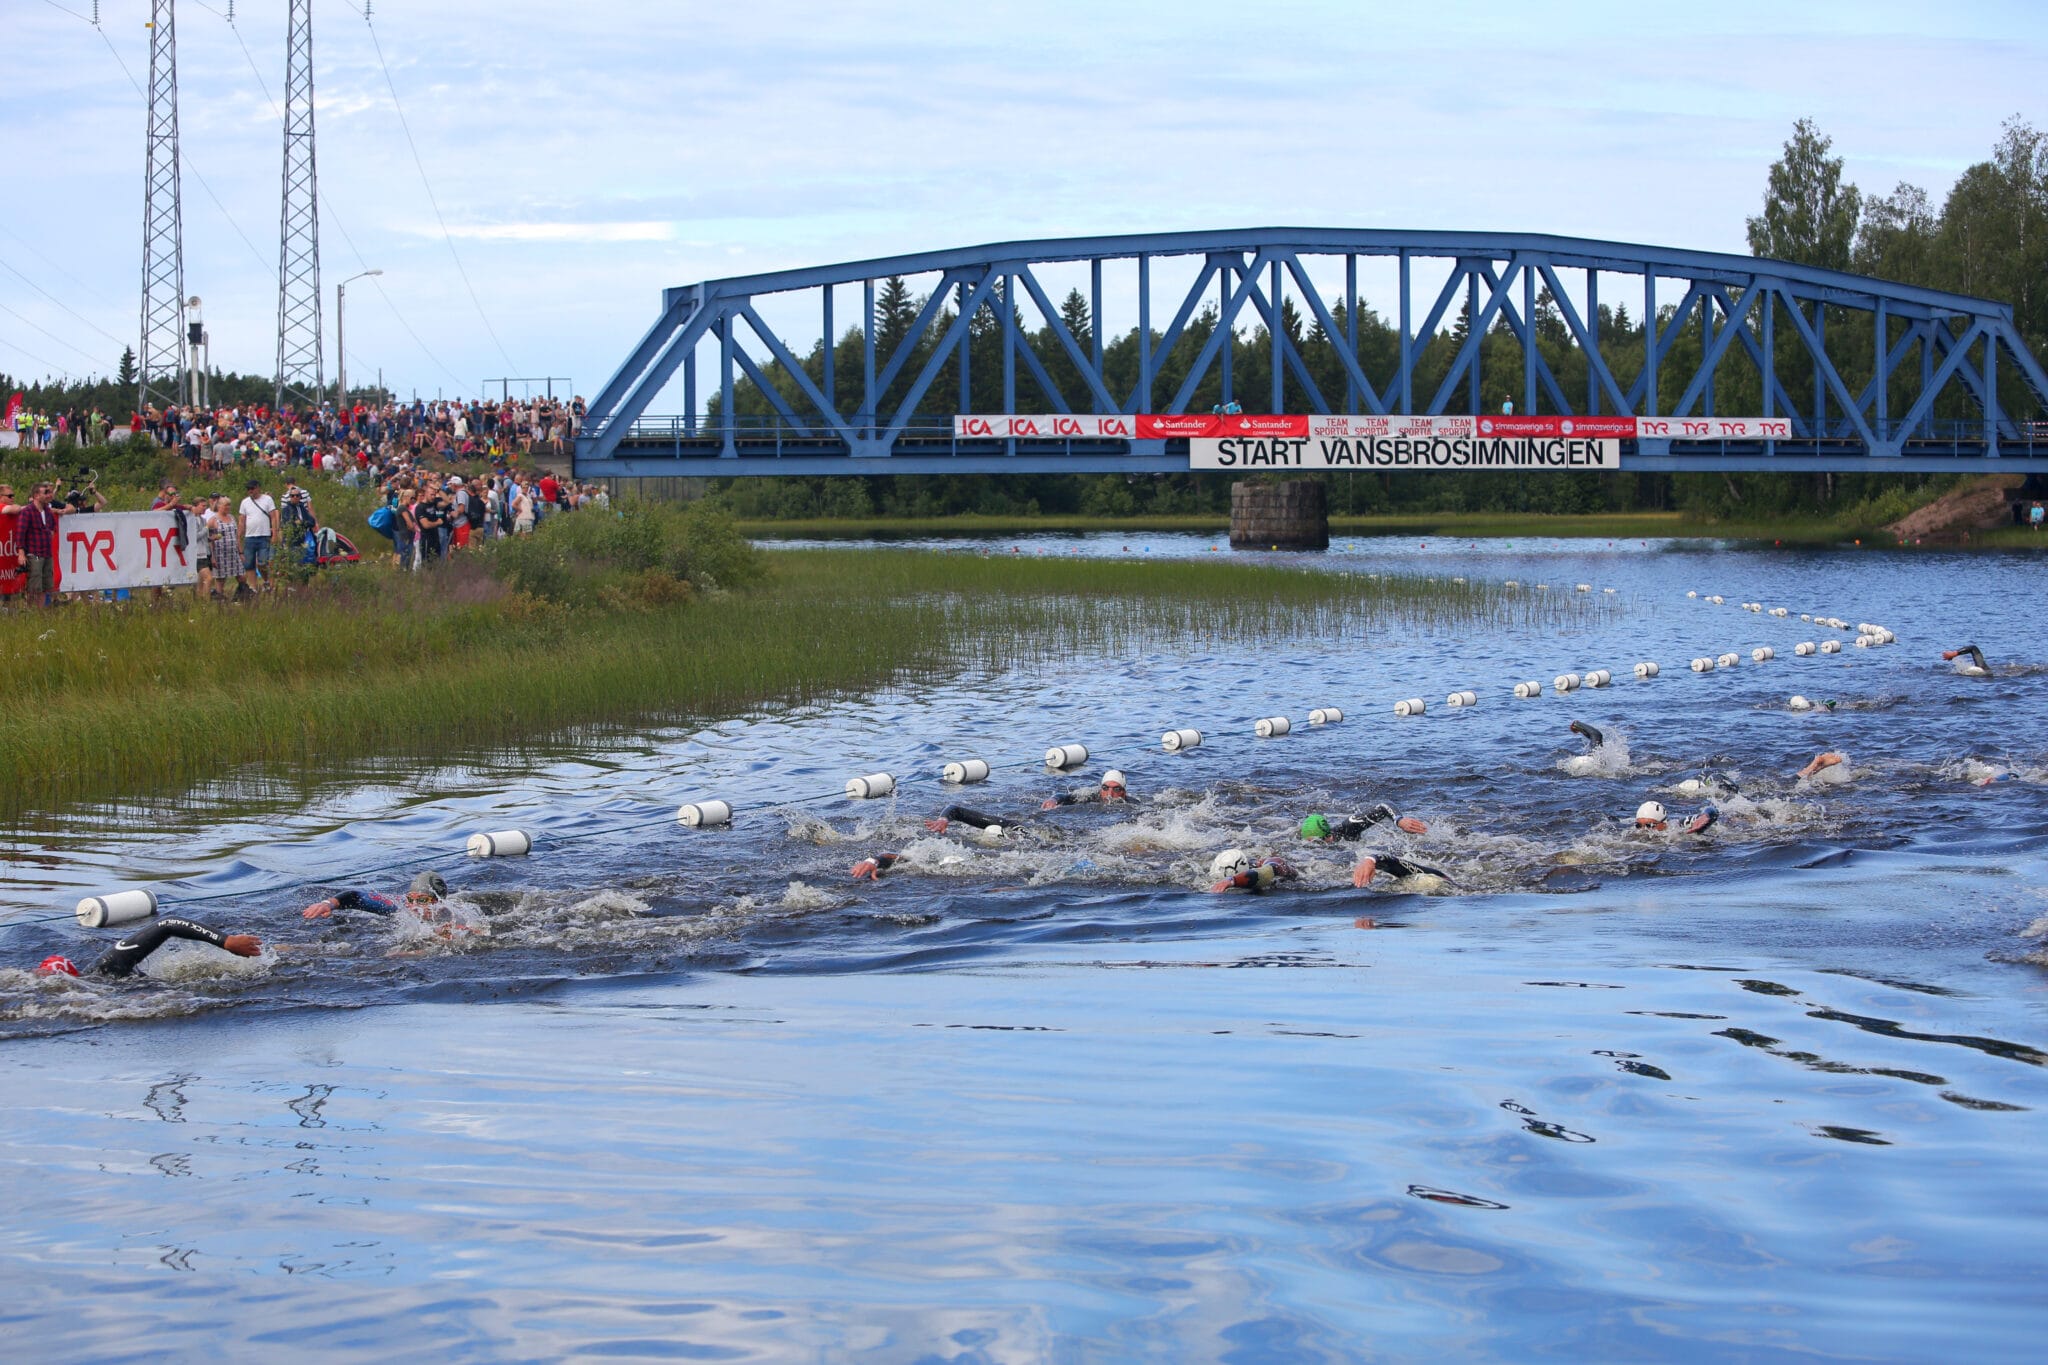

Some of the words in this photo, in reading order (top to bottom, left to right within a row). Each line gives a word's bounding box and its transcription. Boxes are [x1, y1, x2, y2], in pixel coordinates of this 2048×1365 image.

[962, 419, 993, 435] ICA
[1008, 419, 1039, 435] ICA
[1053, 418, 1084, 435] ICA
[1098, 418, 1129, 435] ICA
[1165, 419, 1207, 429] Santander
[1252, 419, 1293, 429] Santander
[1326, 418, 1348, 427] TEAM
[1366, 418, 1389, 427] TEAM
[1410, 418, 1432, 427] TEAM
[1450, 418, 1472, 427] TEAM
[1642, 422, 1669, 435] TYR
[1682, 422, 1709, 435] TYR
[1719, 422, 1746, 435] TYR
[1759, 422, 1786, 436] TYR
[1315, 427, 1349, 436] SPORTIA
[1355, 427, 1389, 436] SPORTIA
[1399, 427, 1432, 436] SPORTIA
[1438, 427, 1471, 436] SPORTIA
[1218, 439, 1307, 466] START
[1320, 439, 1603, 466] VANSBROSIMNINGEN
[66, 530, 117, 574] TYR
[0, 568, 16, 581] ANK
[158, 918, 190, 927] MARLIN
[190, 923, 219, 940] BLACK
